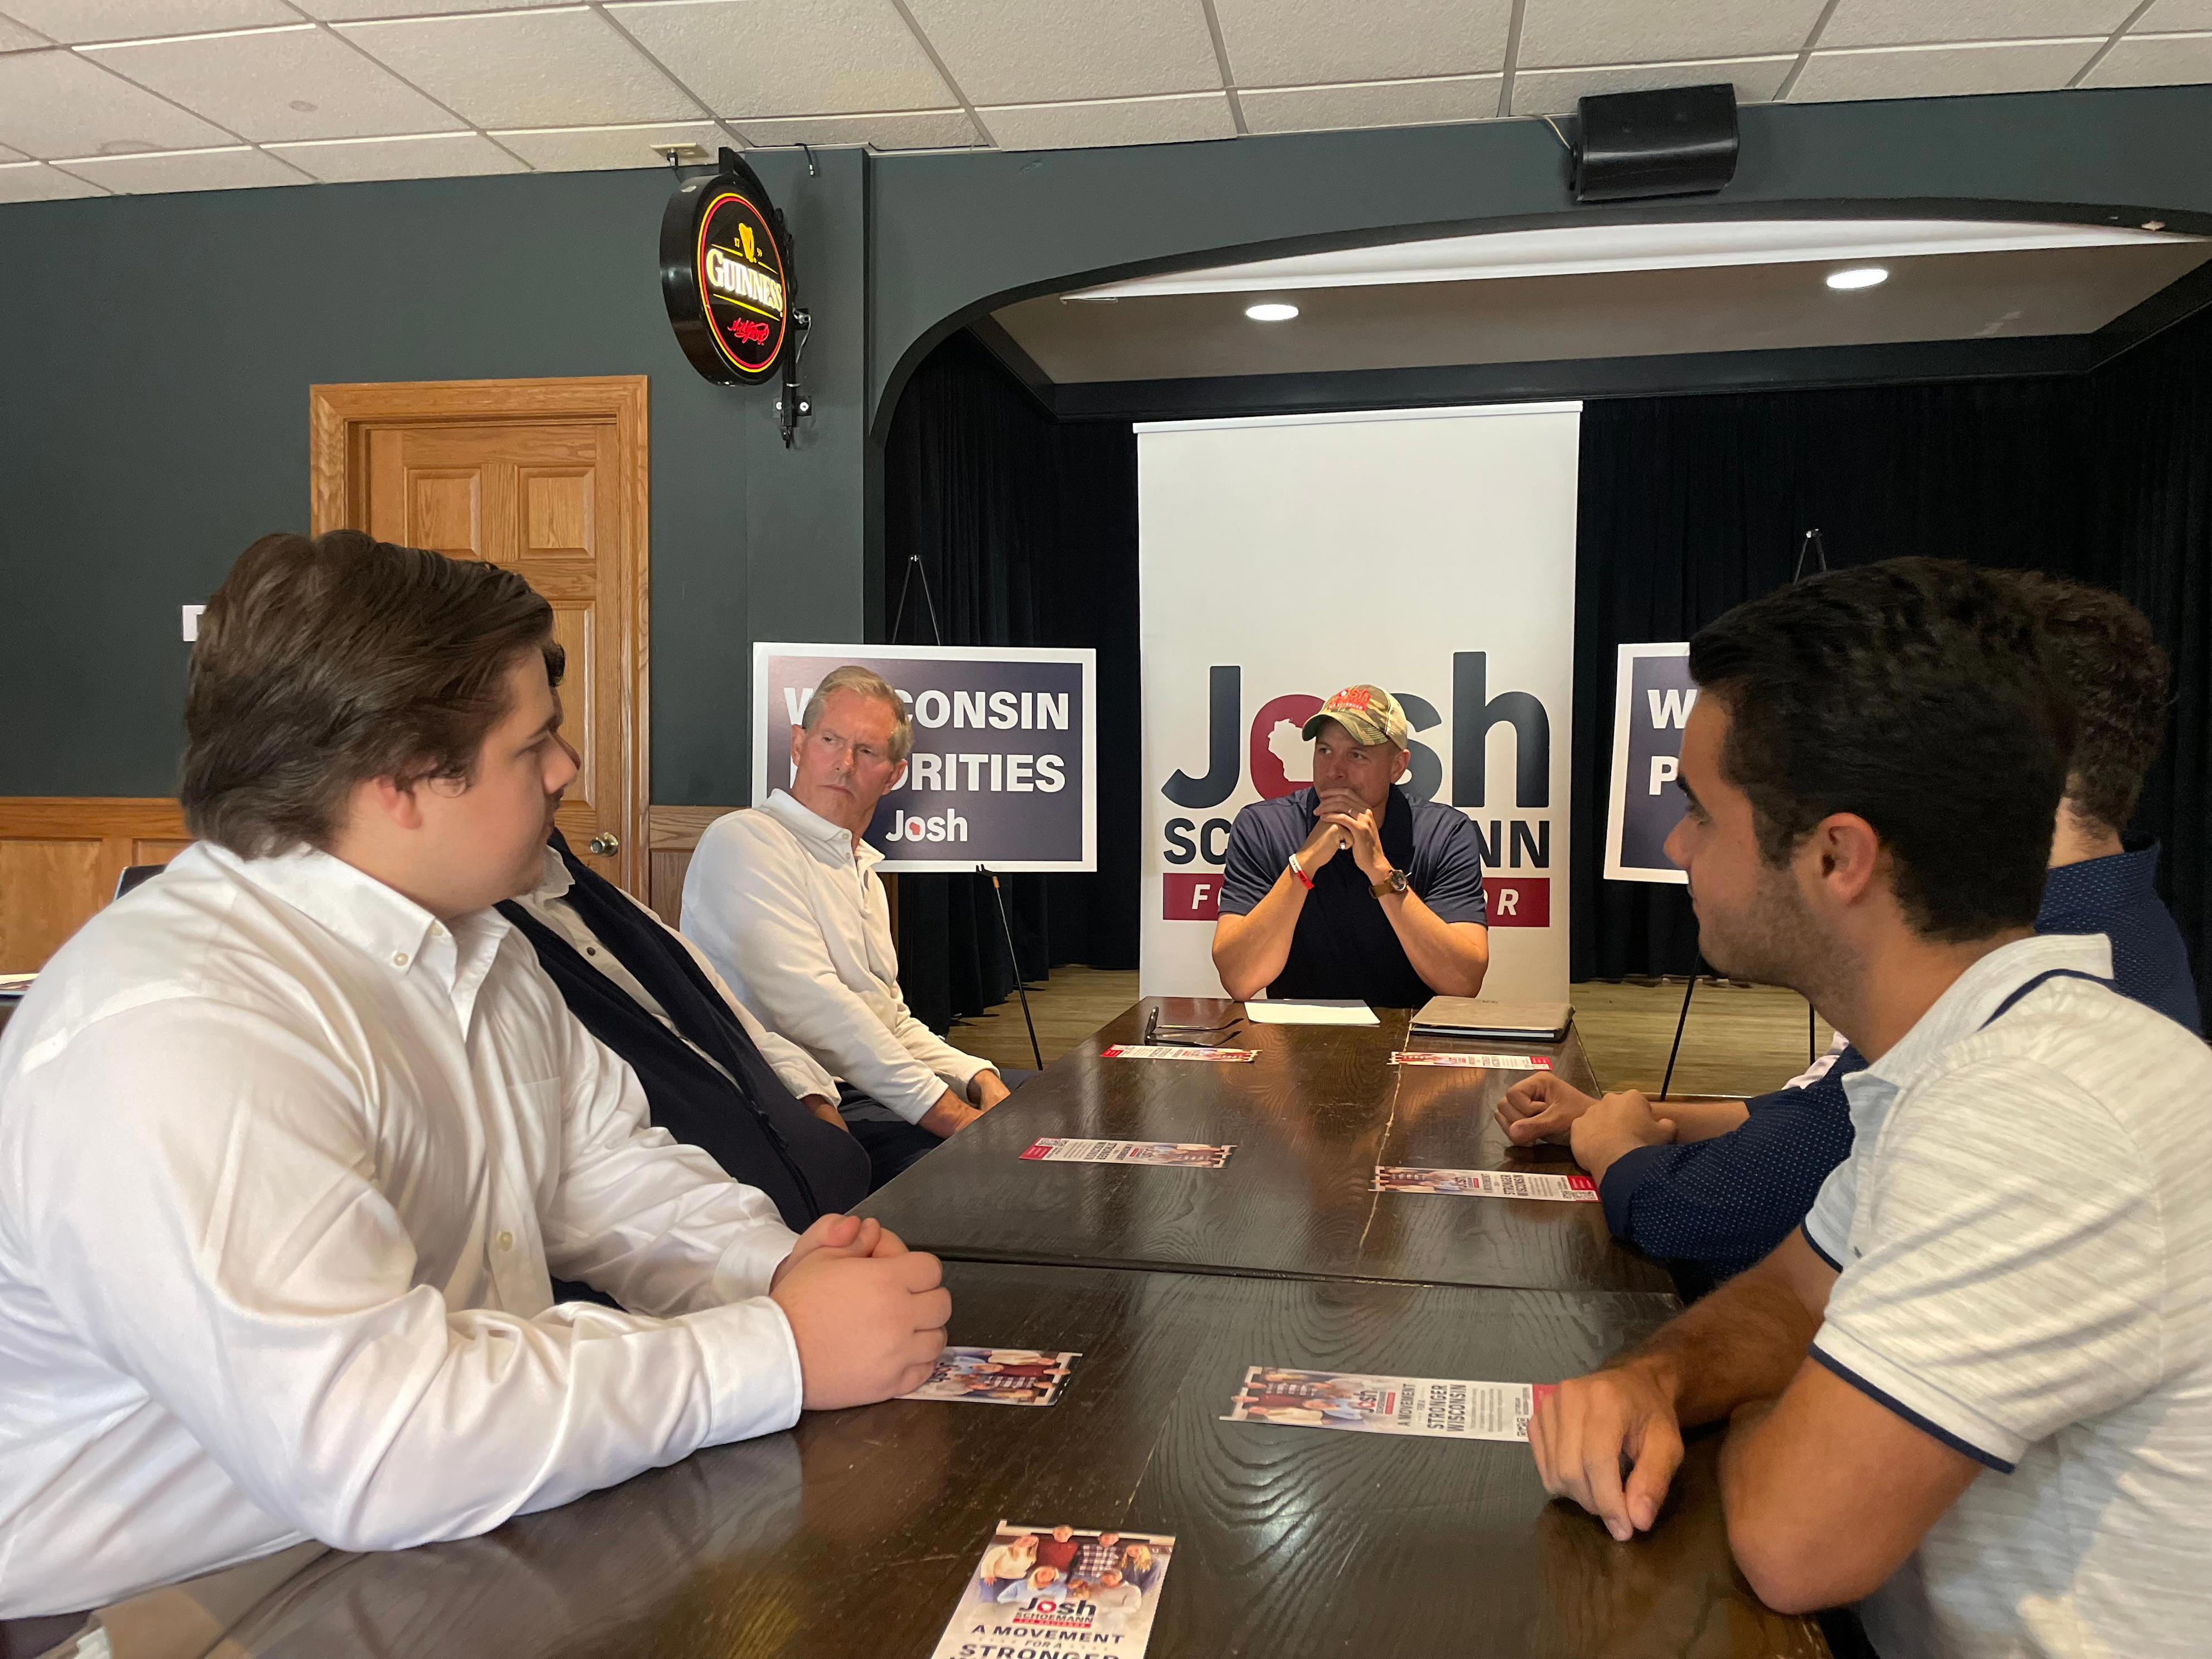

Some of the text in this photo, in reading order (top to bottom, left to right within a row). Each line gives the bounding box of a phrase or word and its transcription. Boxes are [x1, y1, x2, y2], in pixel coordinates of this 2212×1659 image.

[706, 248, 783, 312] GUINNESS
[784, 687, 1069, 730] WONSIN
[885, 808, 968, 842] Josh
[1427, 1385, 1447, 1429] STRONGER
[1447, 1384, 1467, 1431] WISCONSIN
[1016, 1612, 1093, 1623] SCHOEMANN
[1019, 1598, 1097, 1616] Josh
[971, 1624, 1125, 1644] A MOVEMENT
[1025, 1640, 1050, 1648] FOR
